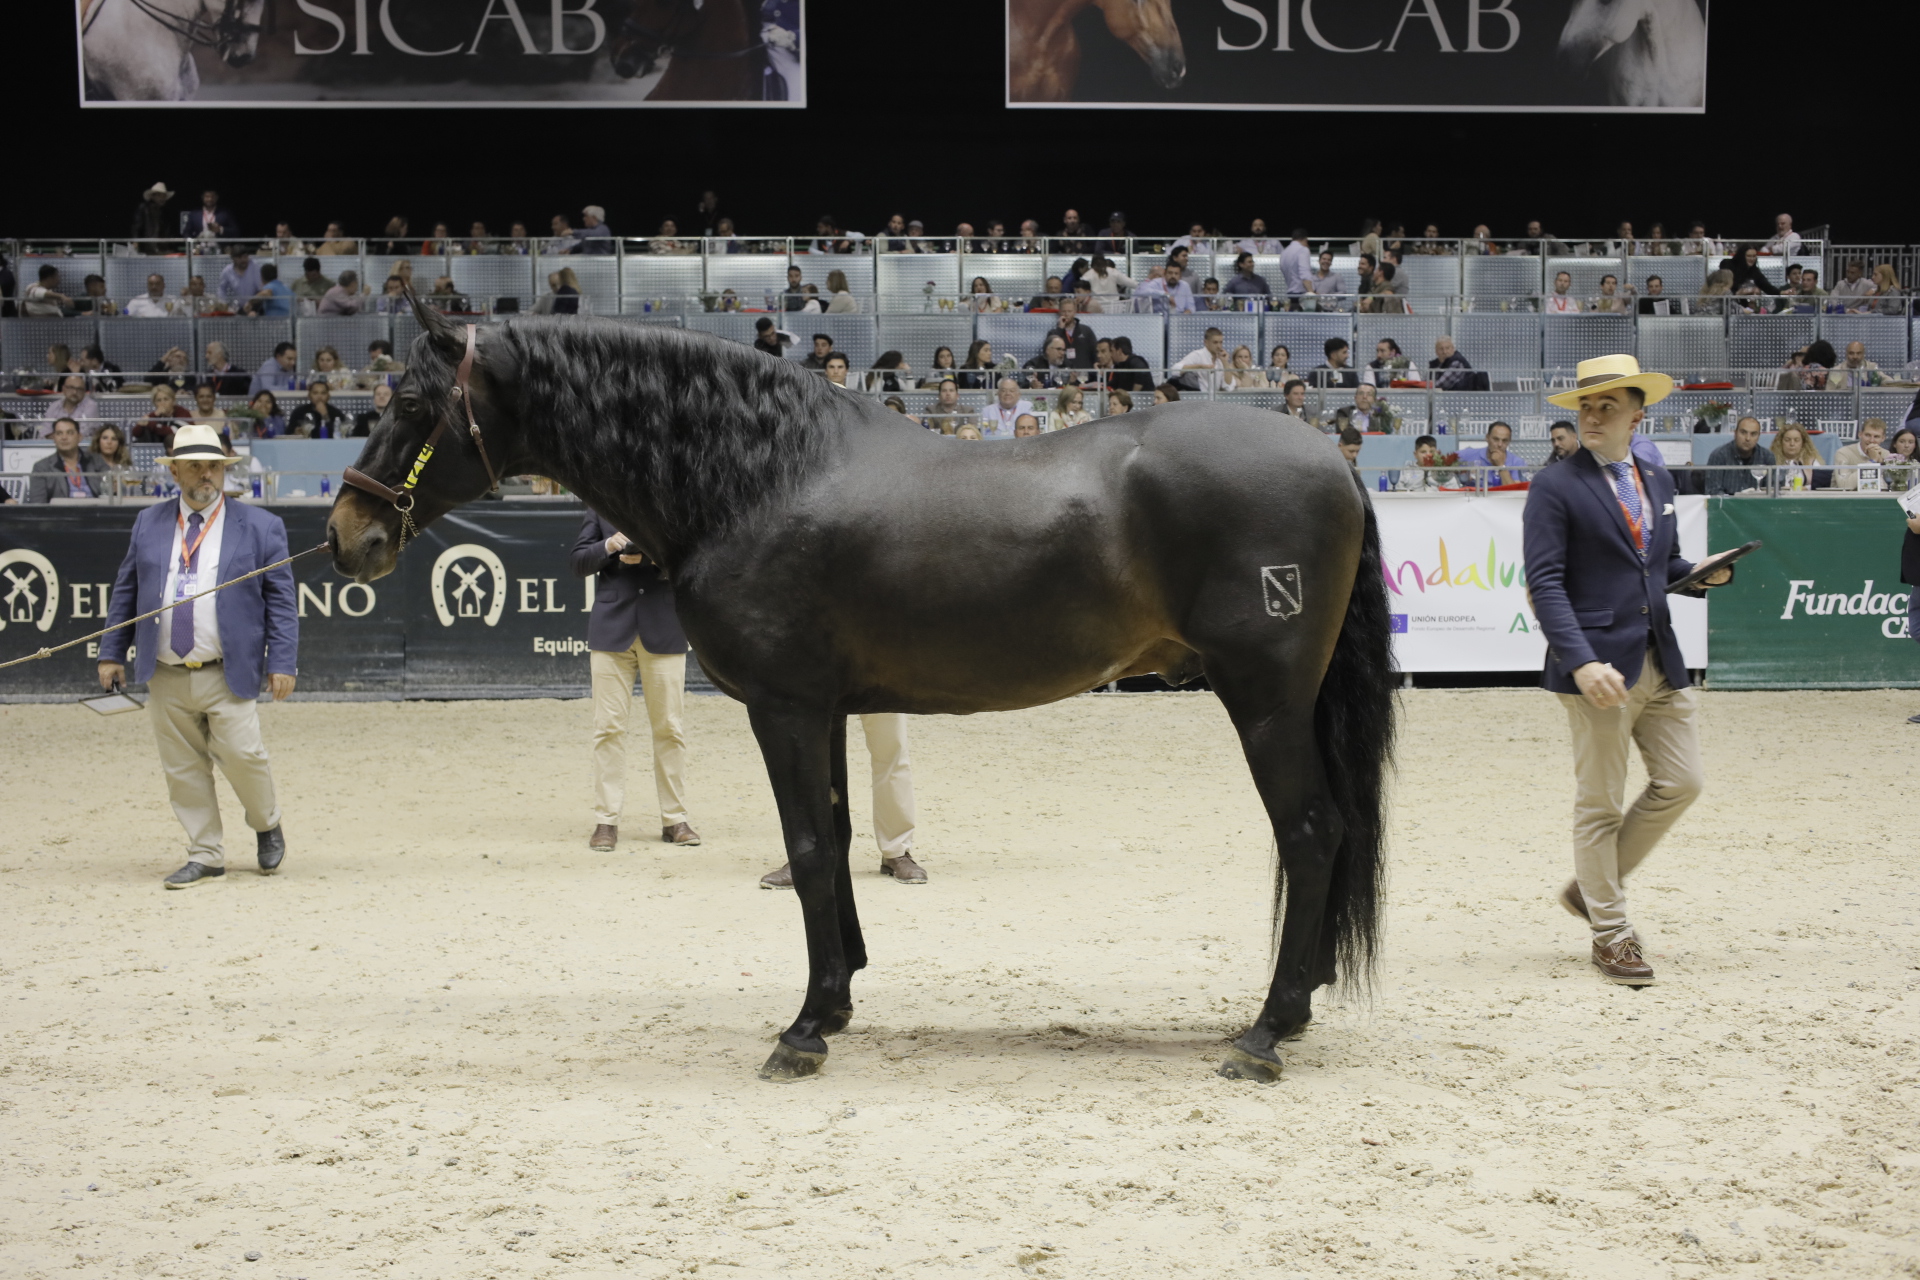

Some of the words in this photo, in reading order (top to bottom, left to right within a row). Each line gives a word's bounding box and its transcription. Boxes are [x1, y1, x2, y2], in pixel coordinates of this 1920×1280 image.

[294, 0, 606, 57] SICAB
[1217, 0, 1521, 53] SICAB
[516, 577, 566, 613] EL
[1780, 579, 1911, 620] Fundac
[1411, 614, 1436, 623] UNIÓN
[1438, 615, 1476, 623] EUROPEA
